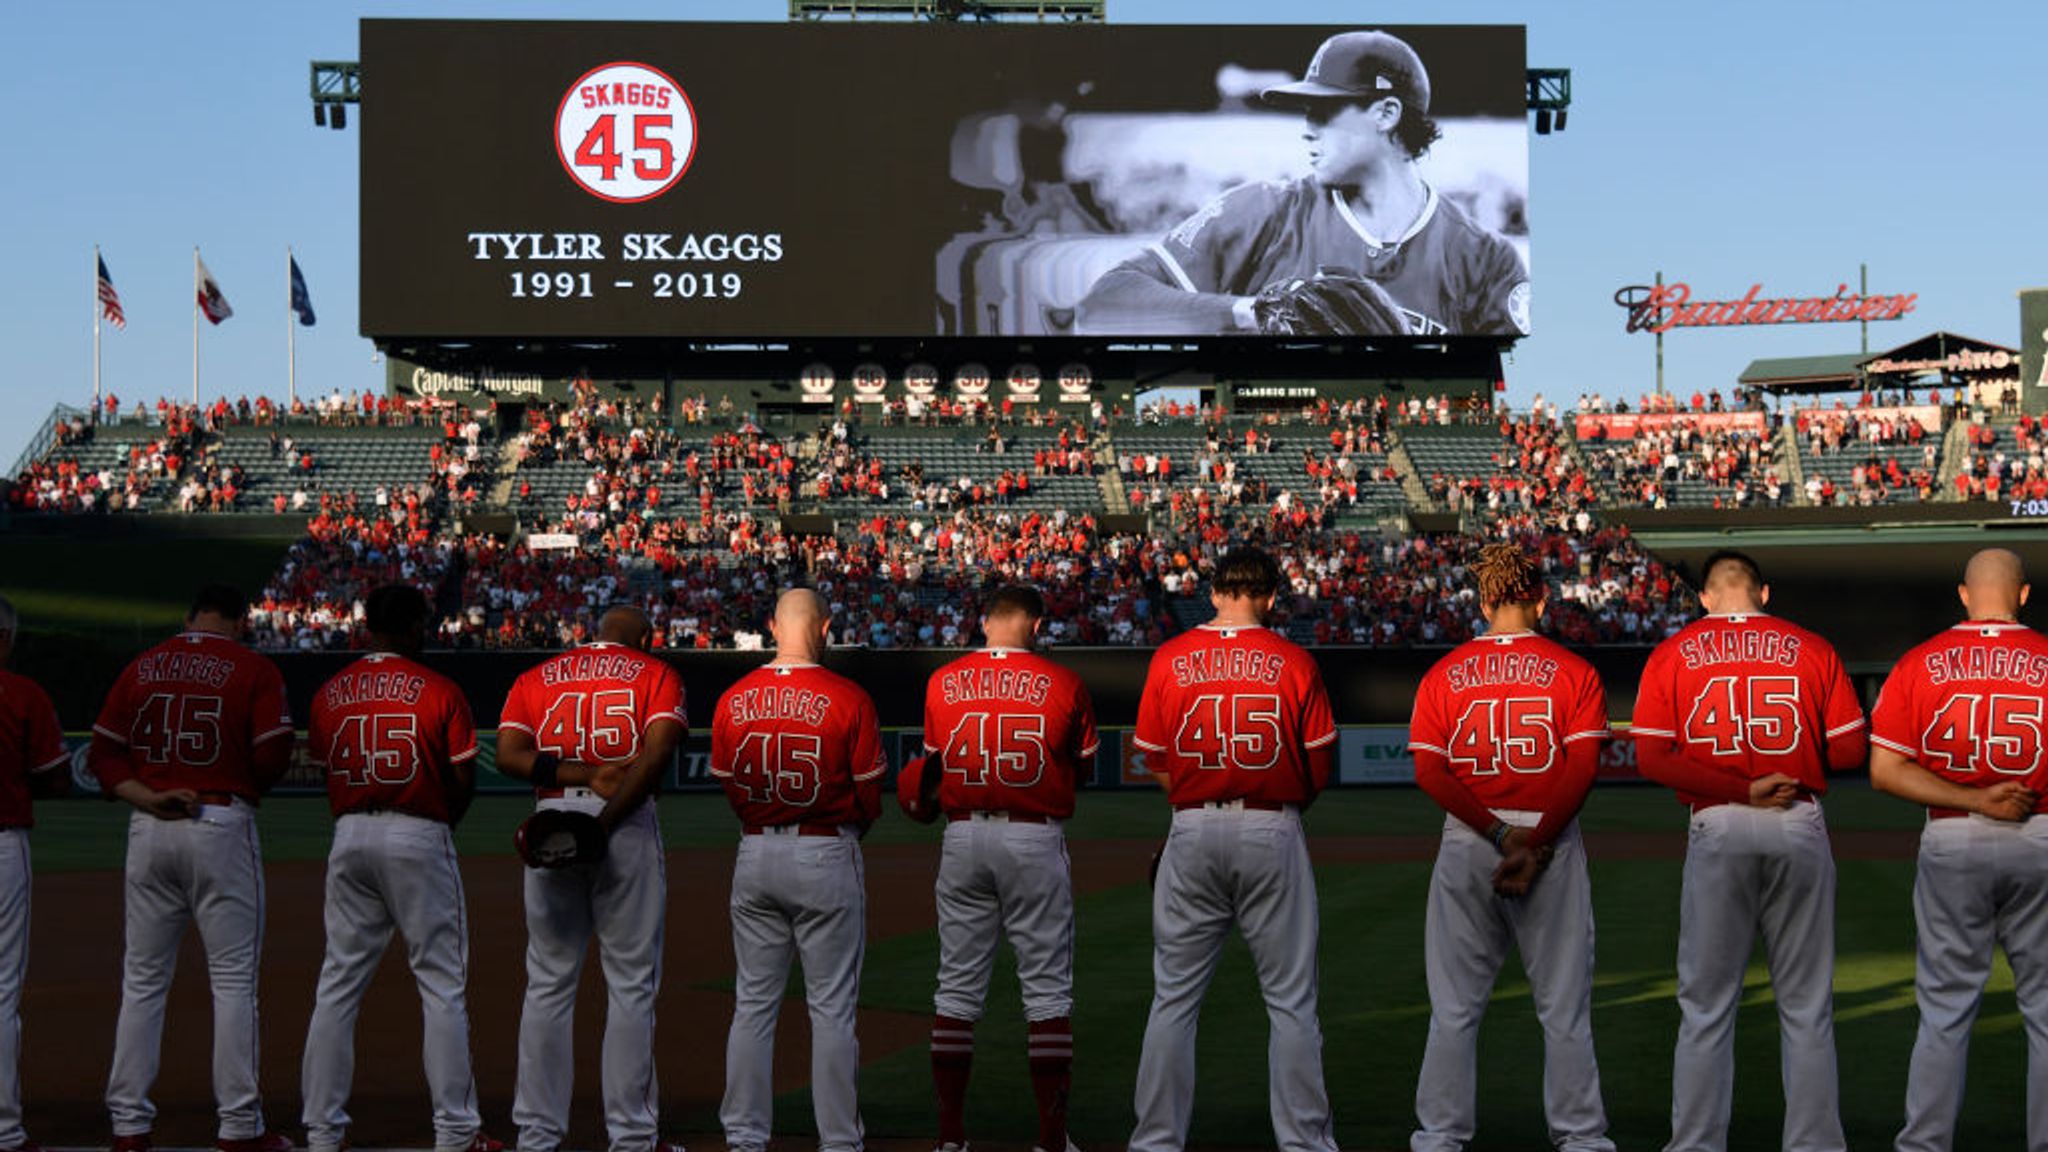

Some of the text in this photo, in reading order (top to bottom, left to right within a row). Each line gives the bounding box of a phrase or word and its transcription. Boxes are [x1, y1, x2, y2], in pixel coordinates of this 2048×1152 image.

[580, 82, 673, 109] SKAGGS
[574, 114, 676, 180] 45
[468, 233, 783, 261] TYLER SKAGGS
[511, 272, 593, 297] 1991
[653, 272, 742, 297] 2019
[1614, 283, 1918, 333] Budweiser
[138, 652, 234, 687] SKAGGS
[1172, 648, 1286, 686] SKAGGS
[1680, 630, 1800, 669] SKAGGS
[1925, 647, 2048, 686] SKAGGS
[542, 655, 645, 685] SKAGGS
[942, 668, 1051, 706] SKAGGS
[1447, 652, 1558, 691] SKAGGS
[325, 672, 425, 709] SKAGGS
[729, 687, 830, 727] SKAGGS
[131, 694, 222, 765] 45
[537, 690, 639, 761] 45
[1175, 694, 1281, 770] 45
[1685, 676, 1801, 755] 45
[1922, 694, 2043, 774] 45
[329, 713, 419, 785] 45
[943, 712, 1045, 787] 45
[1449, 697, 1556, 775] 45
[732, 732, 821, 806] 45
